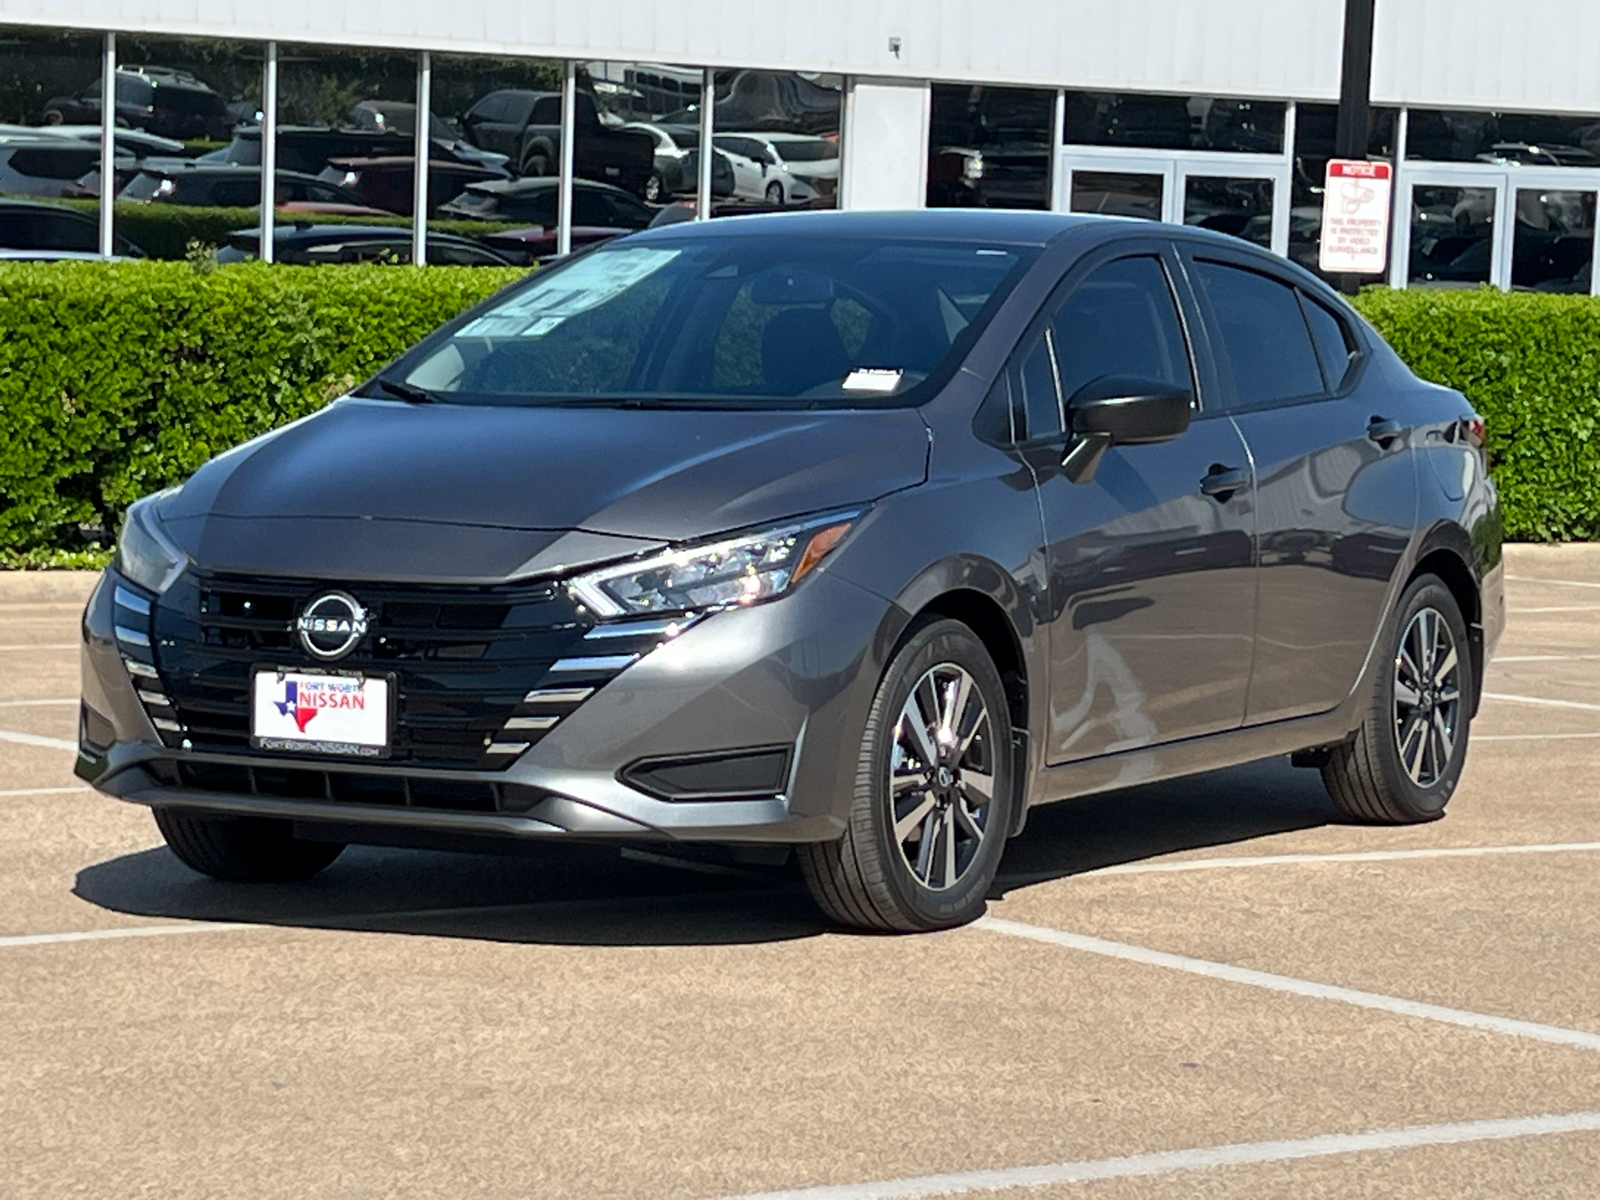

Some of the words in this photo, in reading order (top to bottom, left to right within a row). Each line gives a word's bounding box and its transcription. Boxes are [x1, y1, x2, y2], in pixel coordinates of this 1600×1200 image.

[1342, 165, 1376, 177] NOTICE
[1346, 218, 1381, 226] PROPERTY
[1339, 228, 1379, 236] PROTECTED
[297, 617, 367, 633] NISSAN
[299, 681, 326, 691] FORT
[299, 691, 365, 710] NISSAN
